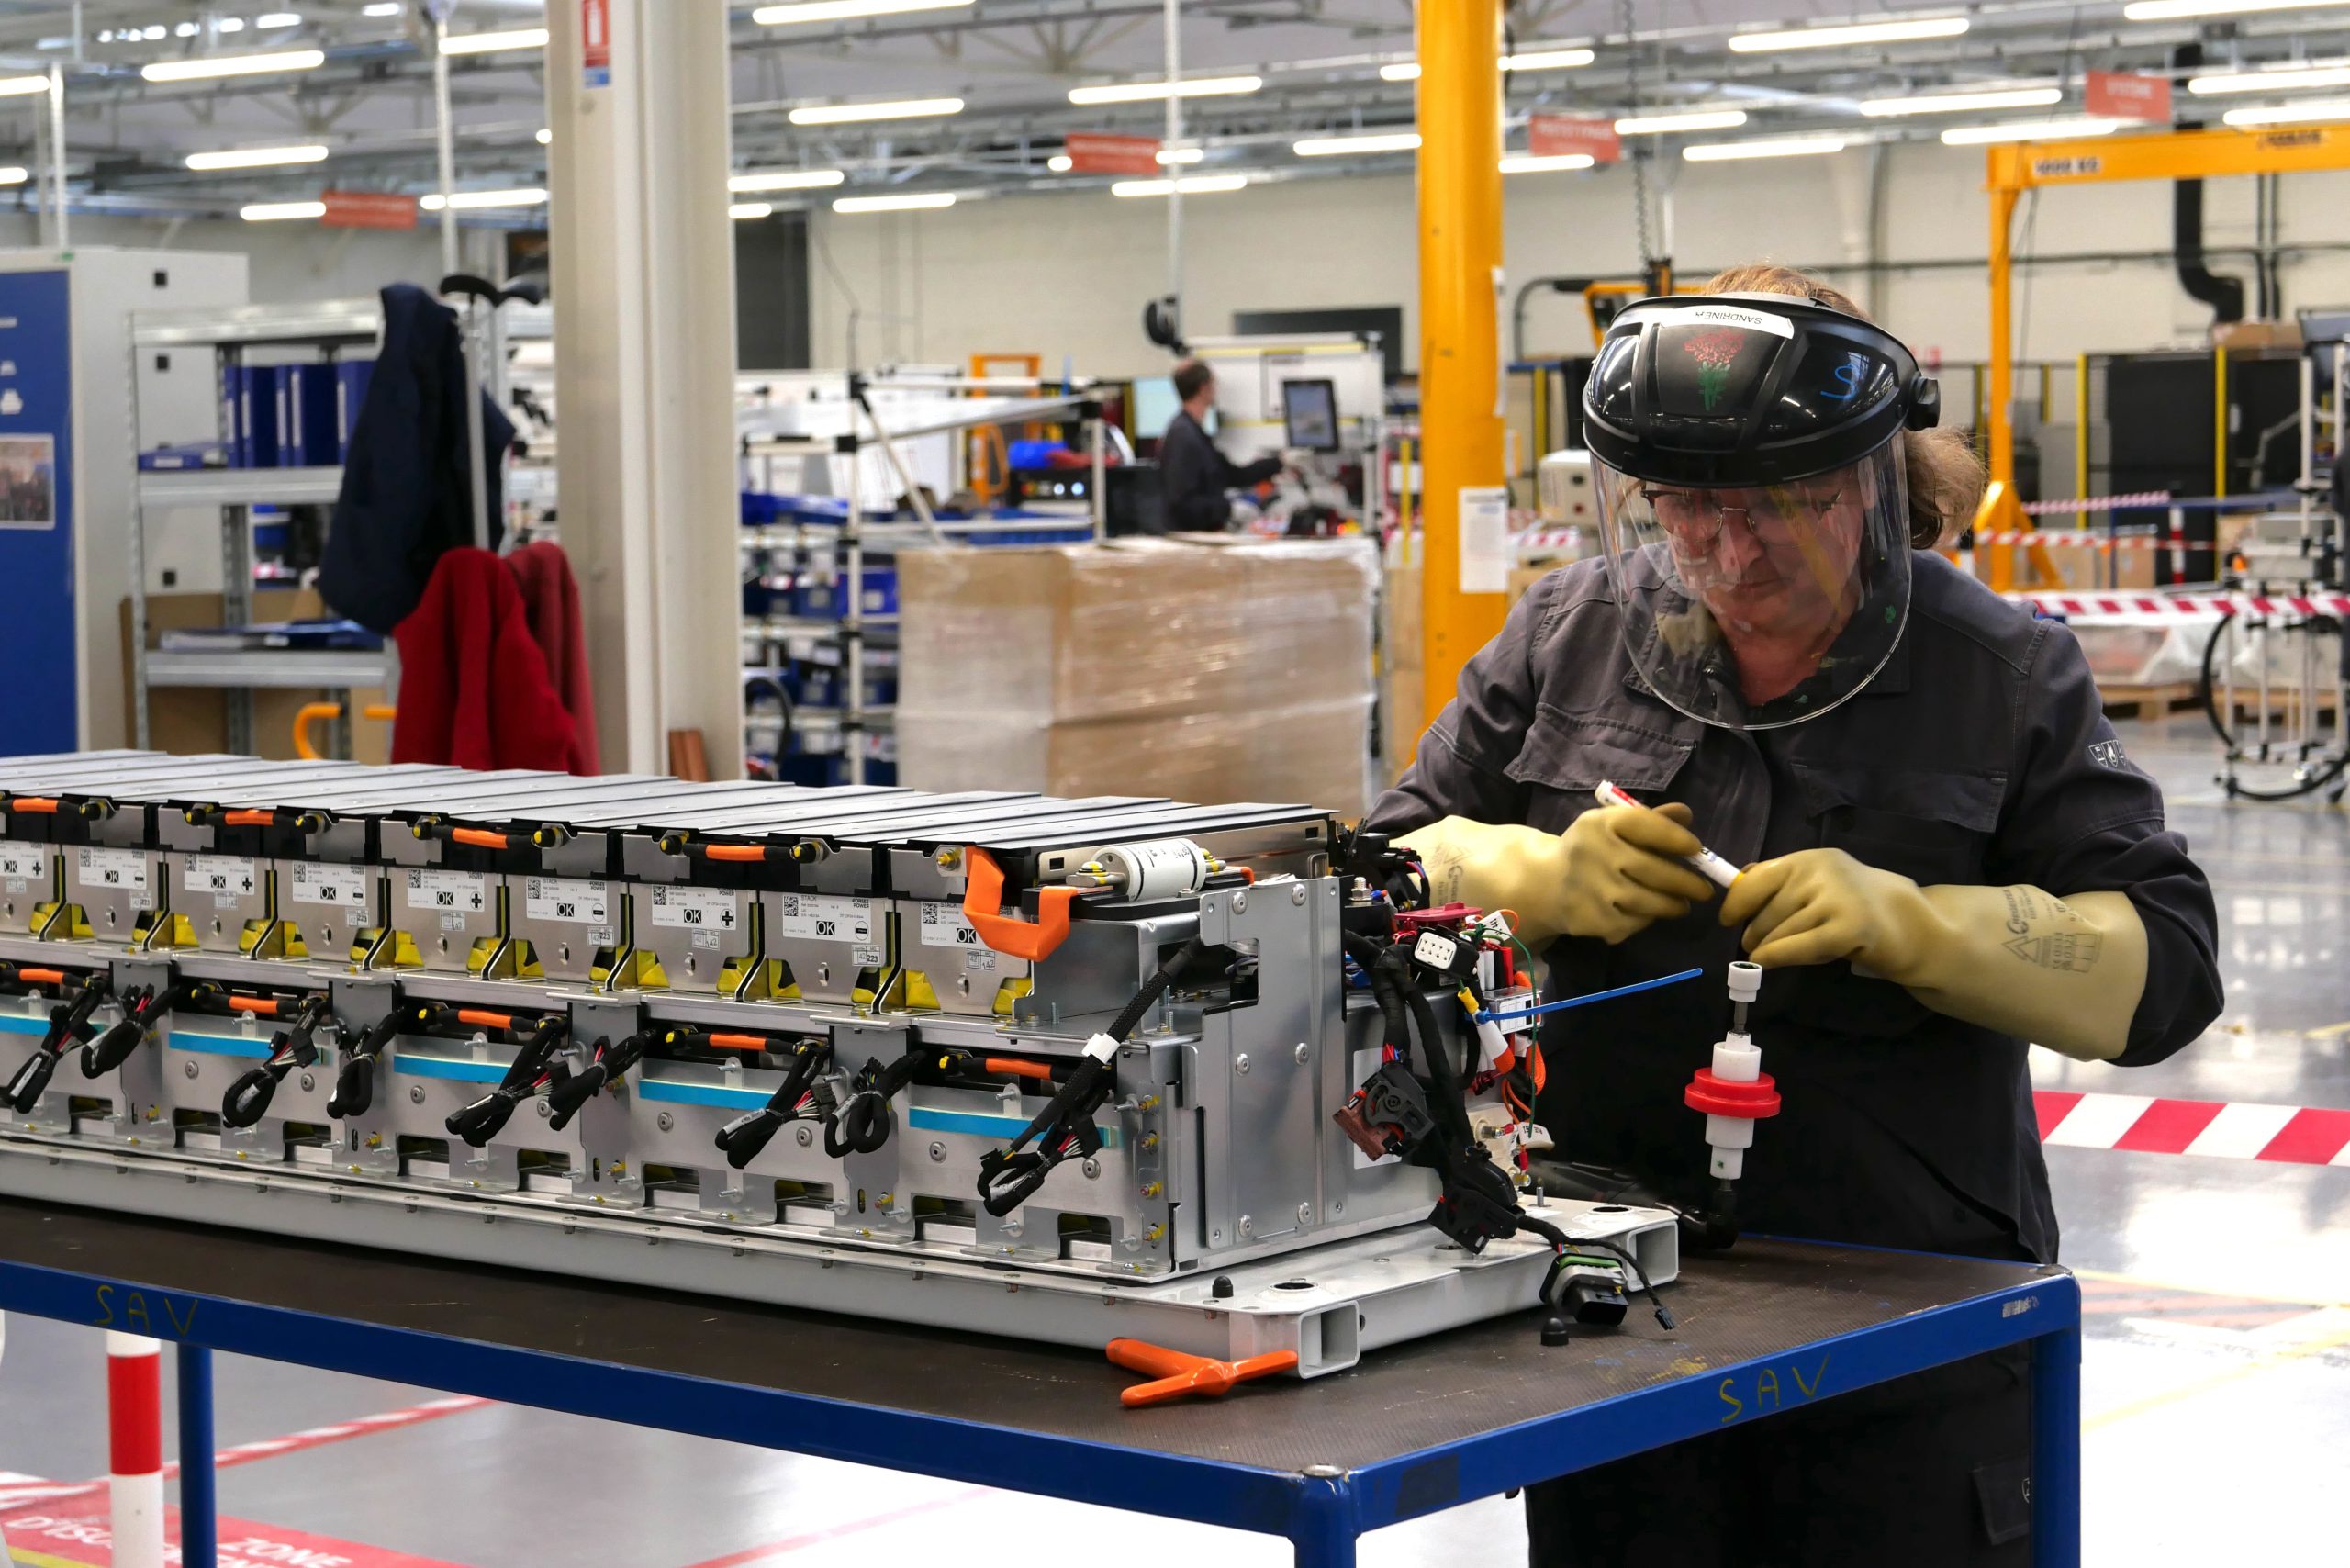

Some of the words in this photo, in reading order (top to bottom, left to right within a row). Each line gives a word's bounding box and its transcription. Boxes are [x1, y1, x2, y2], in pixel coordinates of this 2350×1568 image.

[4, 859, 18, 873] OK
[105, 869, 118, 883] OK
[211, 875, 226, 889] OK
[320, 887, 336, 900] OK
[437, 891, 453, 905] OK
[557, 902, 575, 917] OK
[684, 909, 702, 924] OK
[816, 921, 835, 936] OK
[957, 928, 977, 944] OK
[95, 1284, 199, 1338] SAV
[1719, 1352, 1830, 1423] SAV
